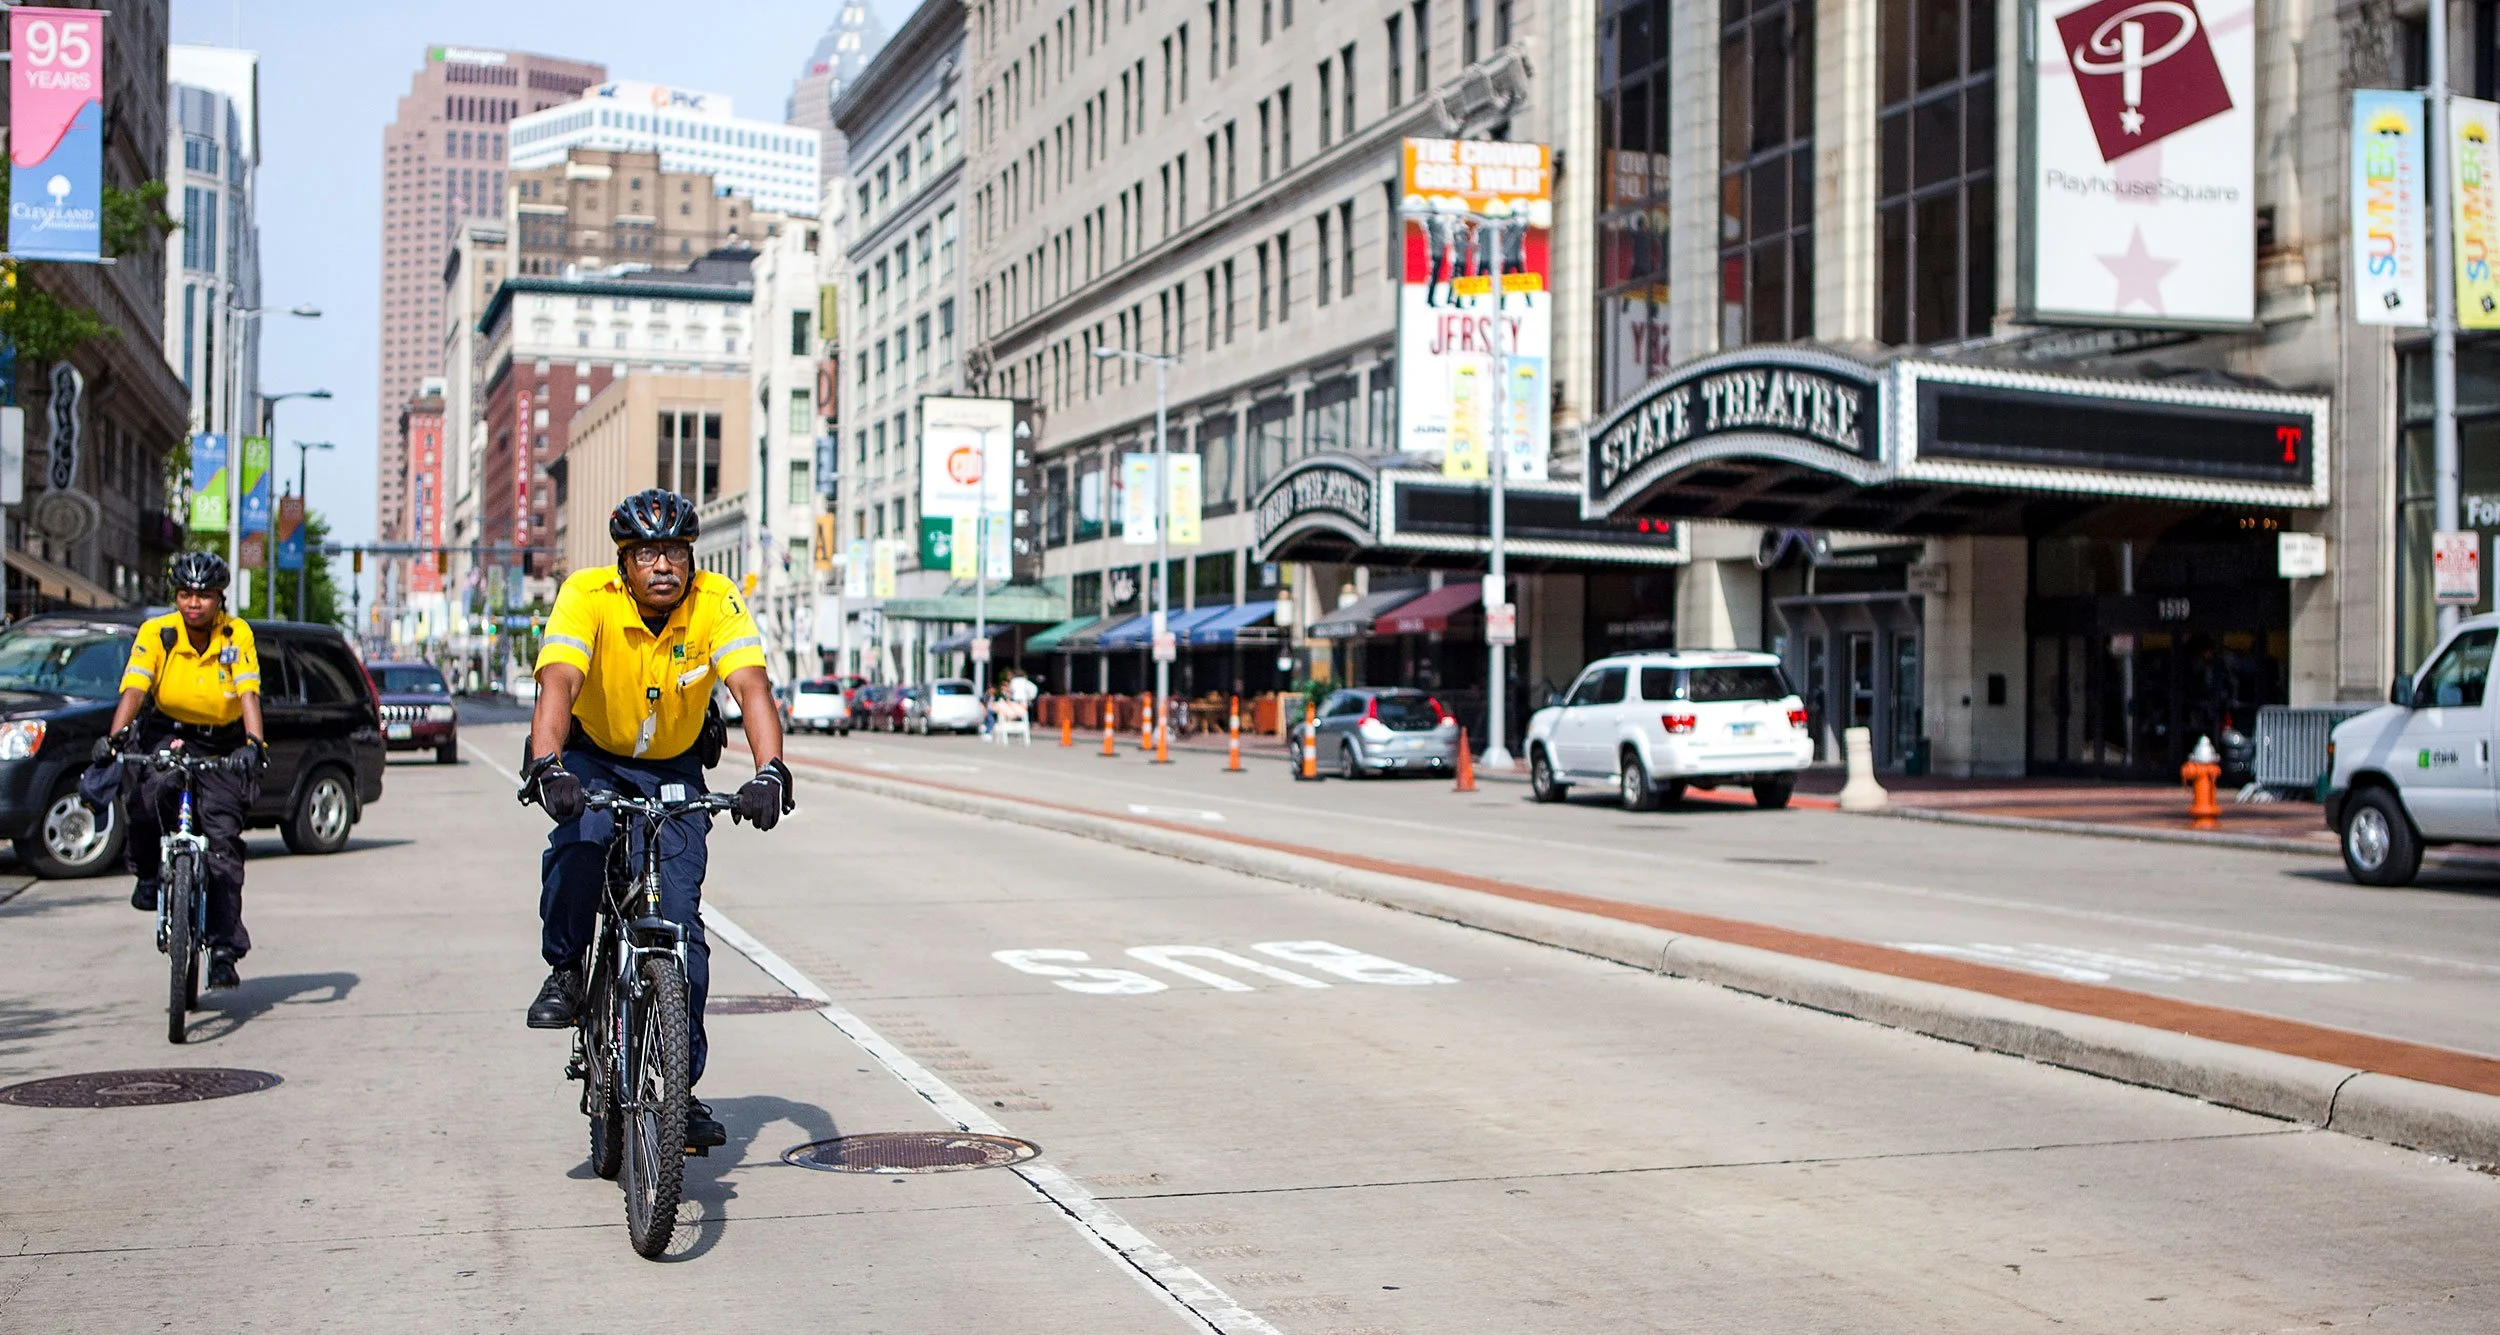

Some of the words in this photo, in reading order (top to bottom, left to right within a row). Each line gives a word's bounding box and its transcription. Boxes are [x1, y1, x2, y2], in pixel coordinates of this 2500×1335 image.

[25, 20, 91, 68] 95
[25, 71, 92, 91] YEARS
[1414, 163, 1473, 190] GOES
[2047, 169, 2240, 204] PlayhouseSquare
[2366, 137, 2397, 277] SUMMER
[2460, 146, 2489, 282] SUMMER
[1430, 315, 1522, 357] JERSEY
[1602, 386, 1692, 488] STATE
[1701, 369, 1860, 450] THEATRE
[2275, 424, 2302, 464] T
[1013, 419, 1031, 556] ALLEN
[991, 940, 1461, 995] BUS
